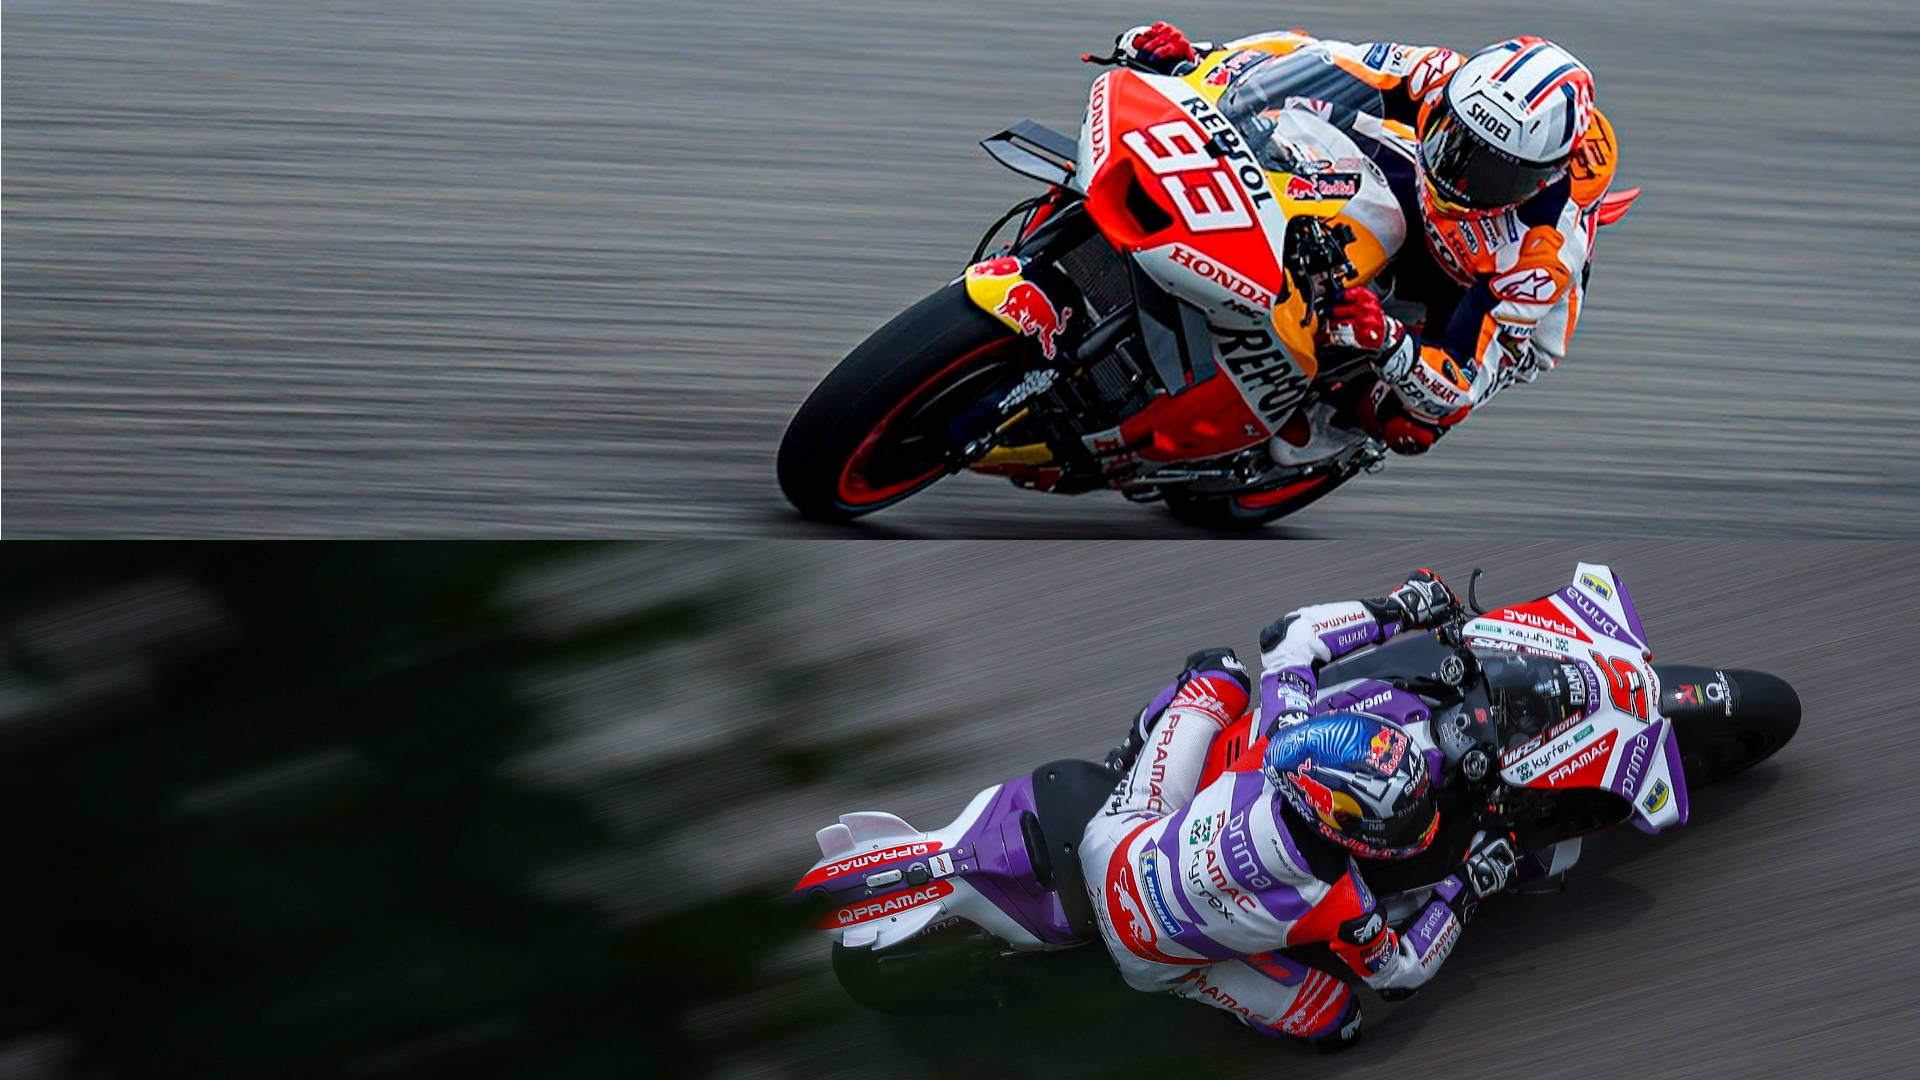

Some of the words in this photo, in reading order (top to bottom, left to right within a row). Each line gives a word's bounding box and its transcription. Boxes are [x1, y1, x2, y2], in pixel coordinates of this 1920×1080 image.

[1090, 77, 1108, 166] HONDA
[1466, 103, 1511, 142] SHOEI
[1120, 119, 1255, 233] 93
[1168, 246, 1271, 311] HONDA
[1428, 378, 1460, 404] HEART
[1312, 611, 1366, 632] PRAMAC
[1503, 609, 1577, 637] PRAMAC
[1566, 586, 1618, 638] prima
[1338, 625, 1368, 647] prima
[1560, 664, 1583, 706] FIAMM
[1581, 663, 1599, 703] prima
[1588, 649, 1649, 724] 5
[1550, 712, 1581, 738] MOTUL
[1146, 714, 1181, 812] PRAMAC
[1548, 740, 1609, 786] PRAMAC
[1622, 734, 1648, 798] prima
[827, 846, 912, 876] PRAMAC
[1227, 811, 1272, 889] prima
[855, 886, 939, 919] PRAMAC
[1146, 875, 1178, 933] MICHELIN
[1421, 906, 1444, 940] prima
[1421, 917, 1458, 969] PRAMAC
